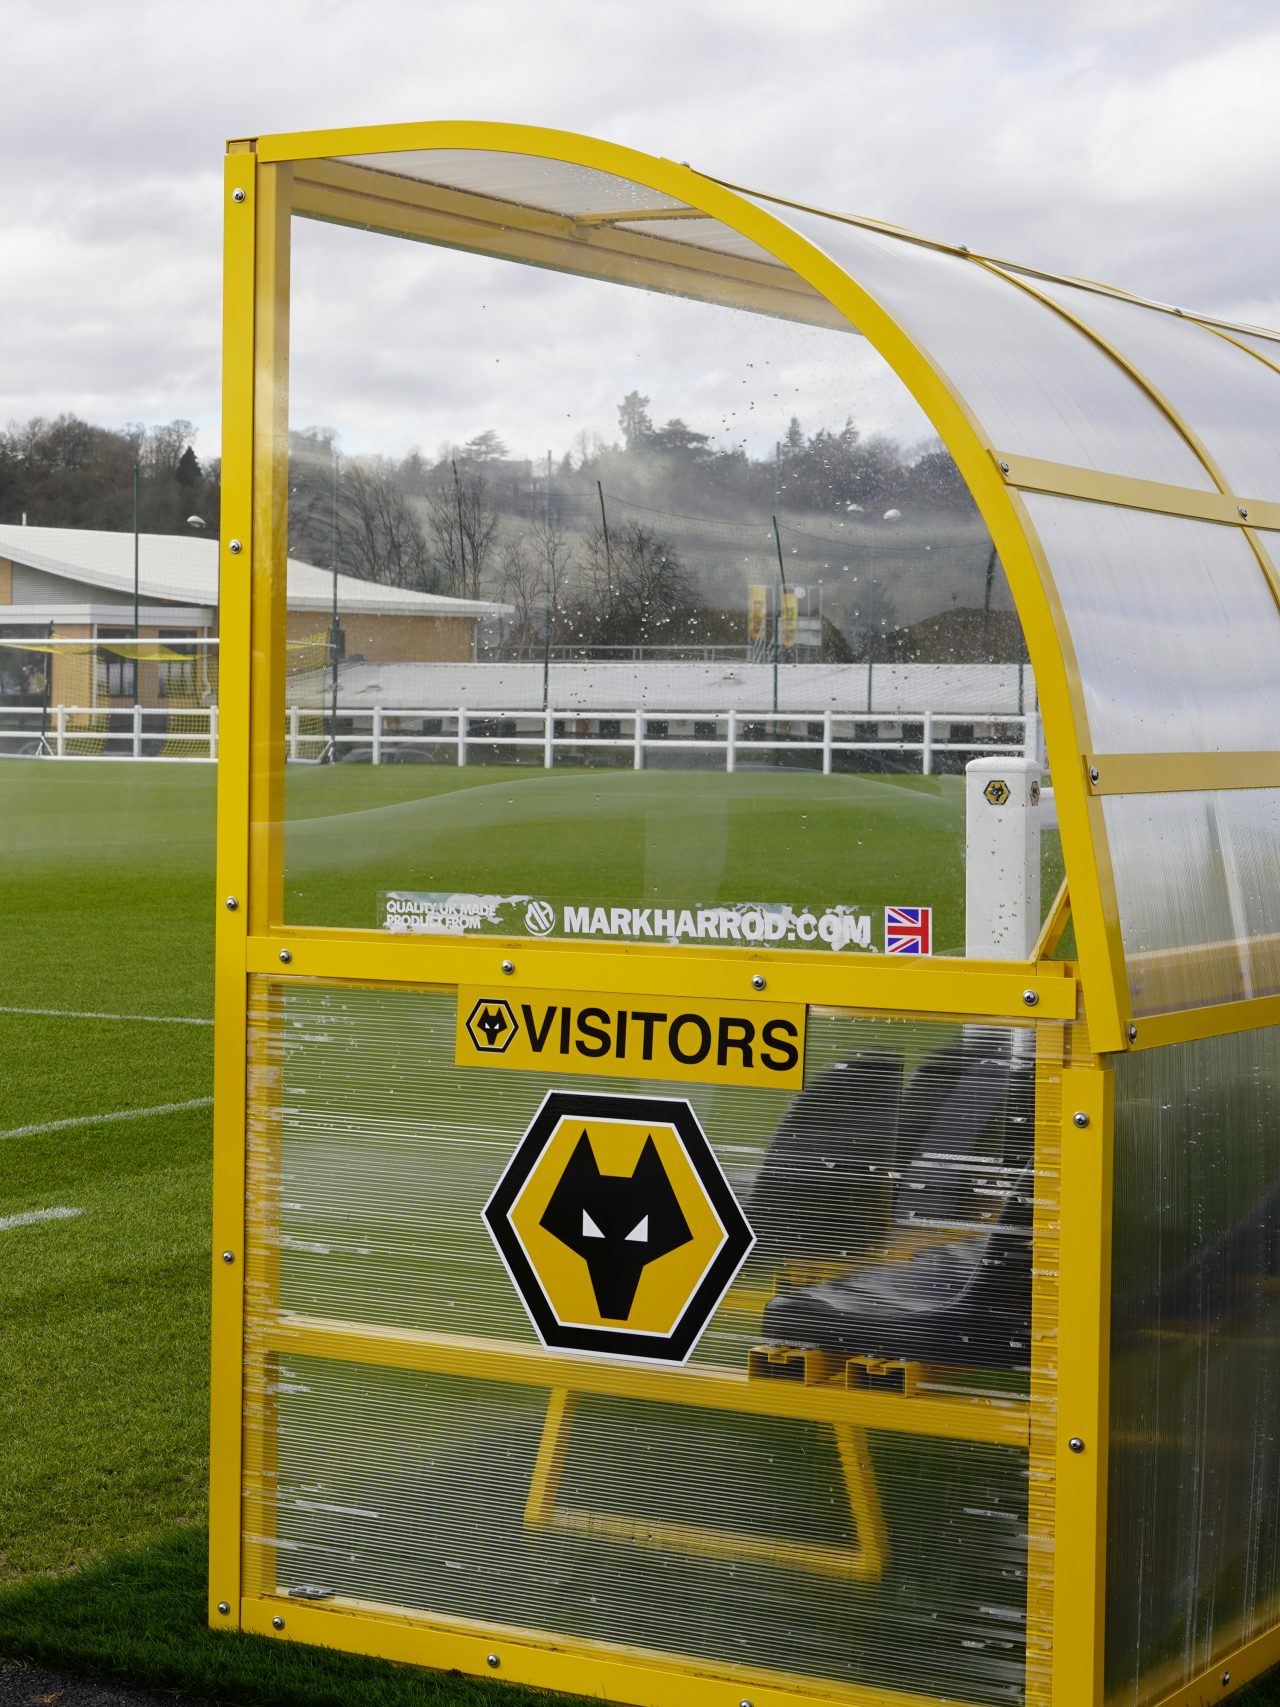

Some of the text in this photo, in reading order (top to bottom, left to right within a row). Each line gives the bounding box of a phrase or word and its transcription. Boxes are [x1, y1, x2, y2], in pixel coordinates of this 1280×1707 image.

[386, 899, 497, 917] QUALITY UK MADE
[386, 914, 481, 929] PRODUCT FROM
[563, 906, 871, 945] MARKHARROD.COM
[521, 1004, 799, 1071] VISITORS
